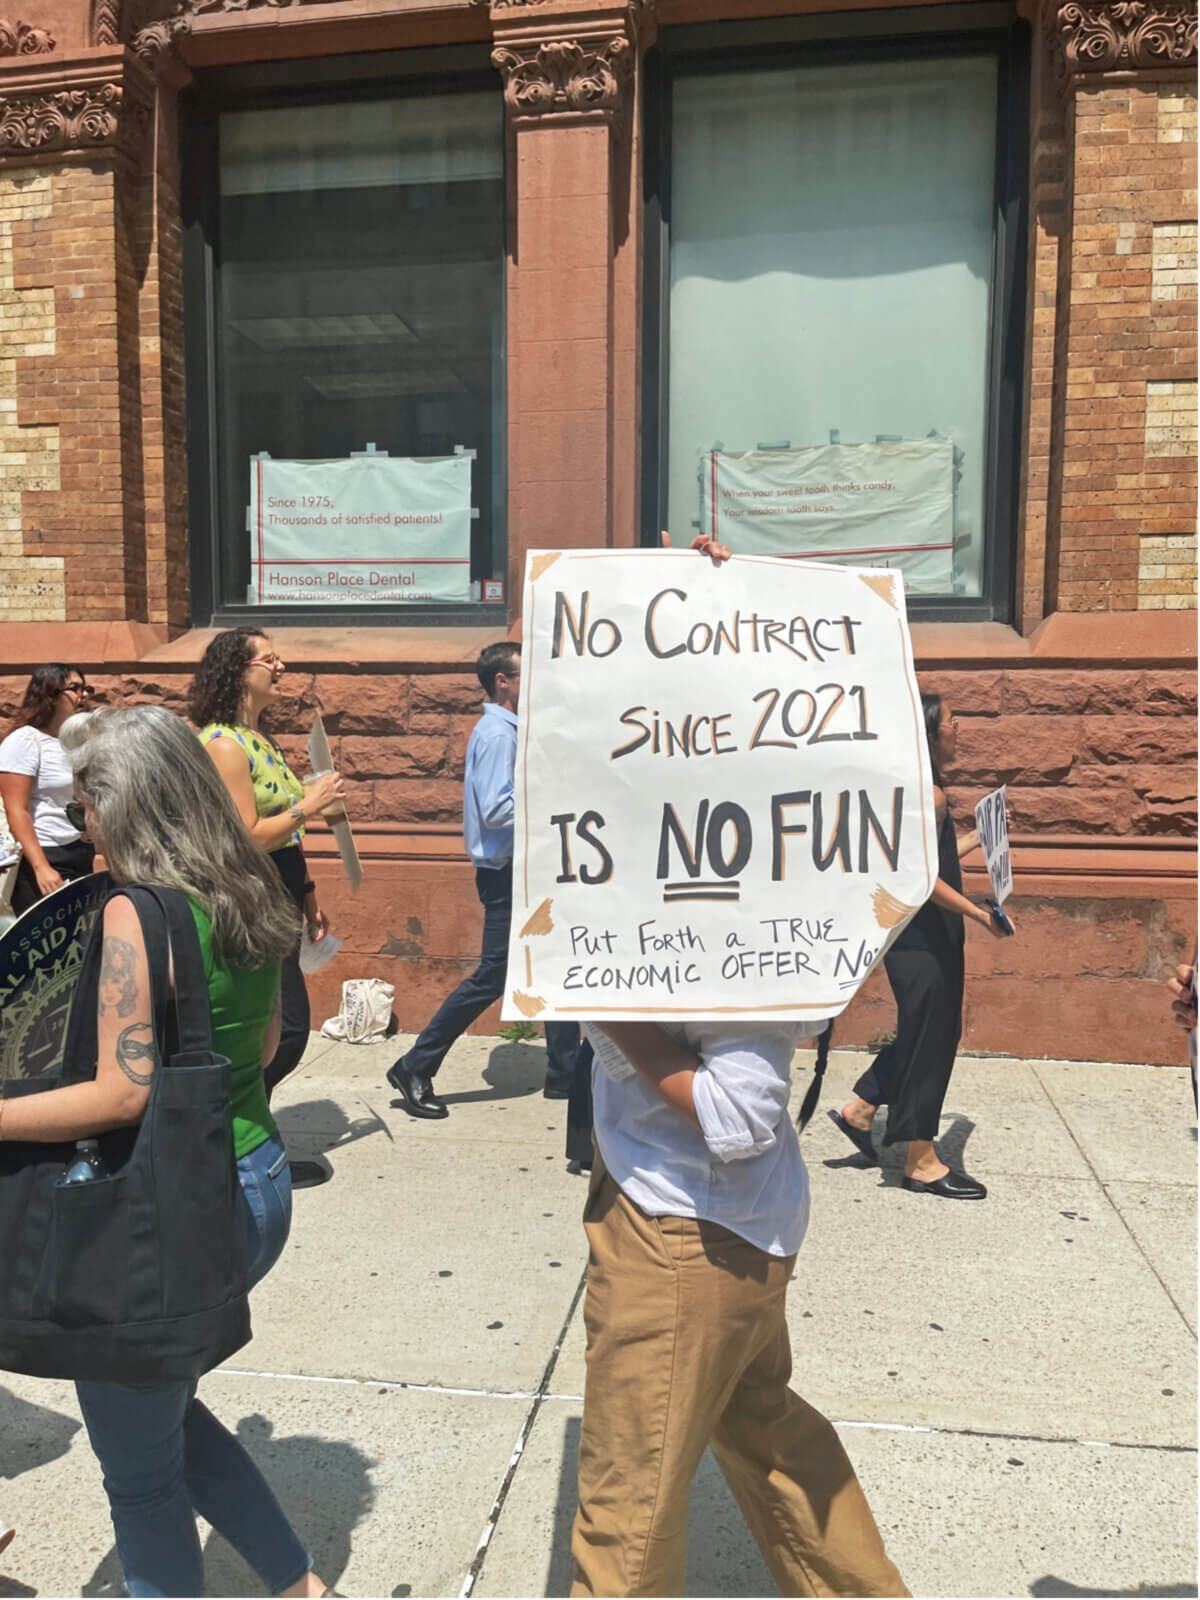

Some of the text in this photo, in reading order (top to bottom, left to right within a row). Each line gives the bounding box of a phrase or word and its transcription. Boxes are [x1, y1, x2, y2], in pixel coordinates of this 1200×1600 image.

[267, 495, 335, 509] Since 1975,
[723, 479, 896, 498] When your sweet tooth thinks candy,
[268, 512, 443, 526] Thousands of satisfied patients!
[723, 508, 744, 518] Your
[269, 570, 416, 585] Hanson Place Dental
[748, 683, 879, 751] 2021
[550, 786, 905, 885] IS NO FUN
[10, 889, 110, 963] ASSOCIATIO
[570, 926, 618, 956] Put
[725, 932, 746, 948] a
[0, 973, 26, 1007] AL
[27, 926, 67, 970] AID
[721, 951, 821, 981] OFFER
